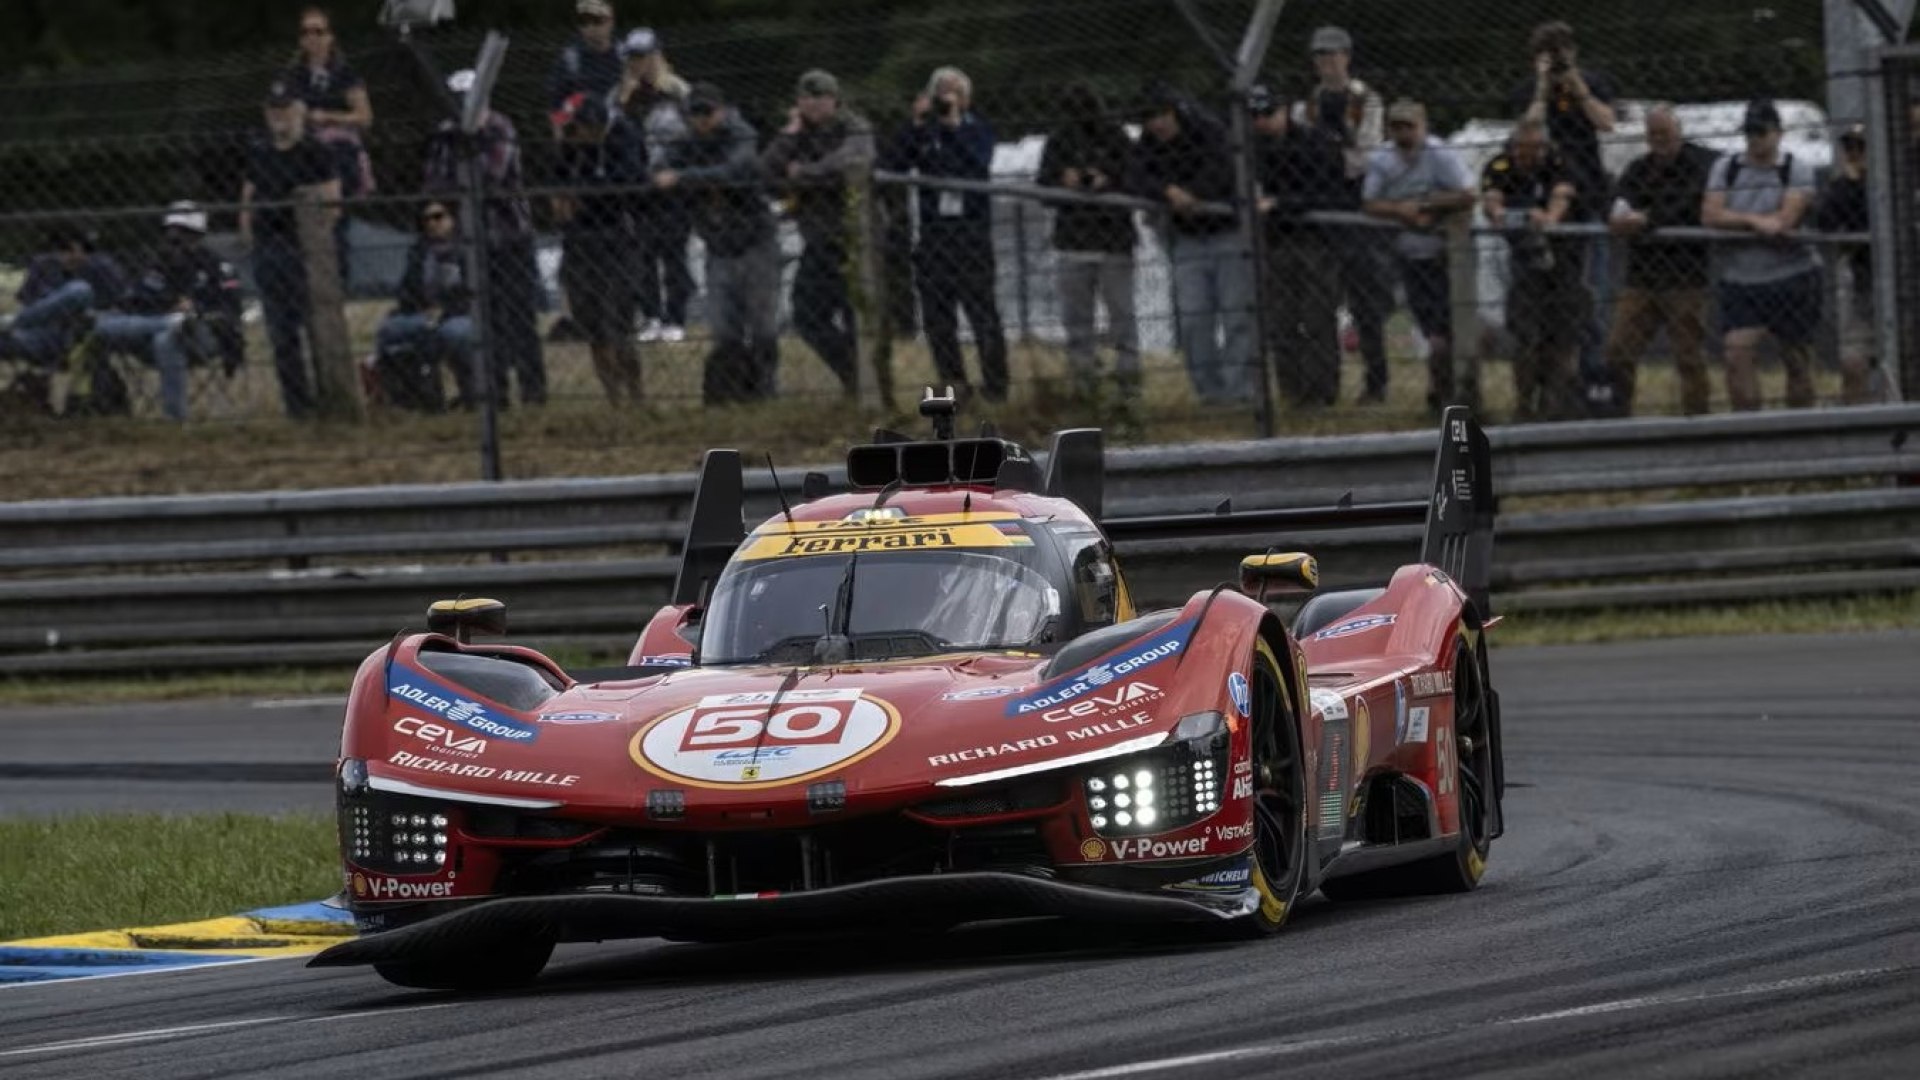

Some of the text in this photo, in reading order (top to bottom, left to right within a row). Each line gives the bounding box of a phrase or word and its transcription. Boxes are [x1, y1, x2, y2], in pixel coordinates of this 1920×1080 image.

[778, 528, 956, 558] Ferrari
[1018, 683, 1090, 713] ADLER
[1114, 640, 1180, 674] GROUP
[390, 684, 533, 739] ADLER GROUP
[1042, 682, 1160, 723] CEVA
[1102, 691, 1166, 717] LOGISTICS
[393, 717, 488, 753] CEVA
[689, 706, 842, 745] 50
[928, 711, 1153, 766] RICHARD MILLE
[389, 751, 580, 786] RICHARD MILLE
[1111, 836, 1209, 859] V-Power
[367, 878, 455, 897] V-Power
